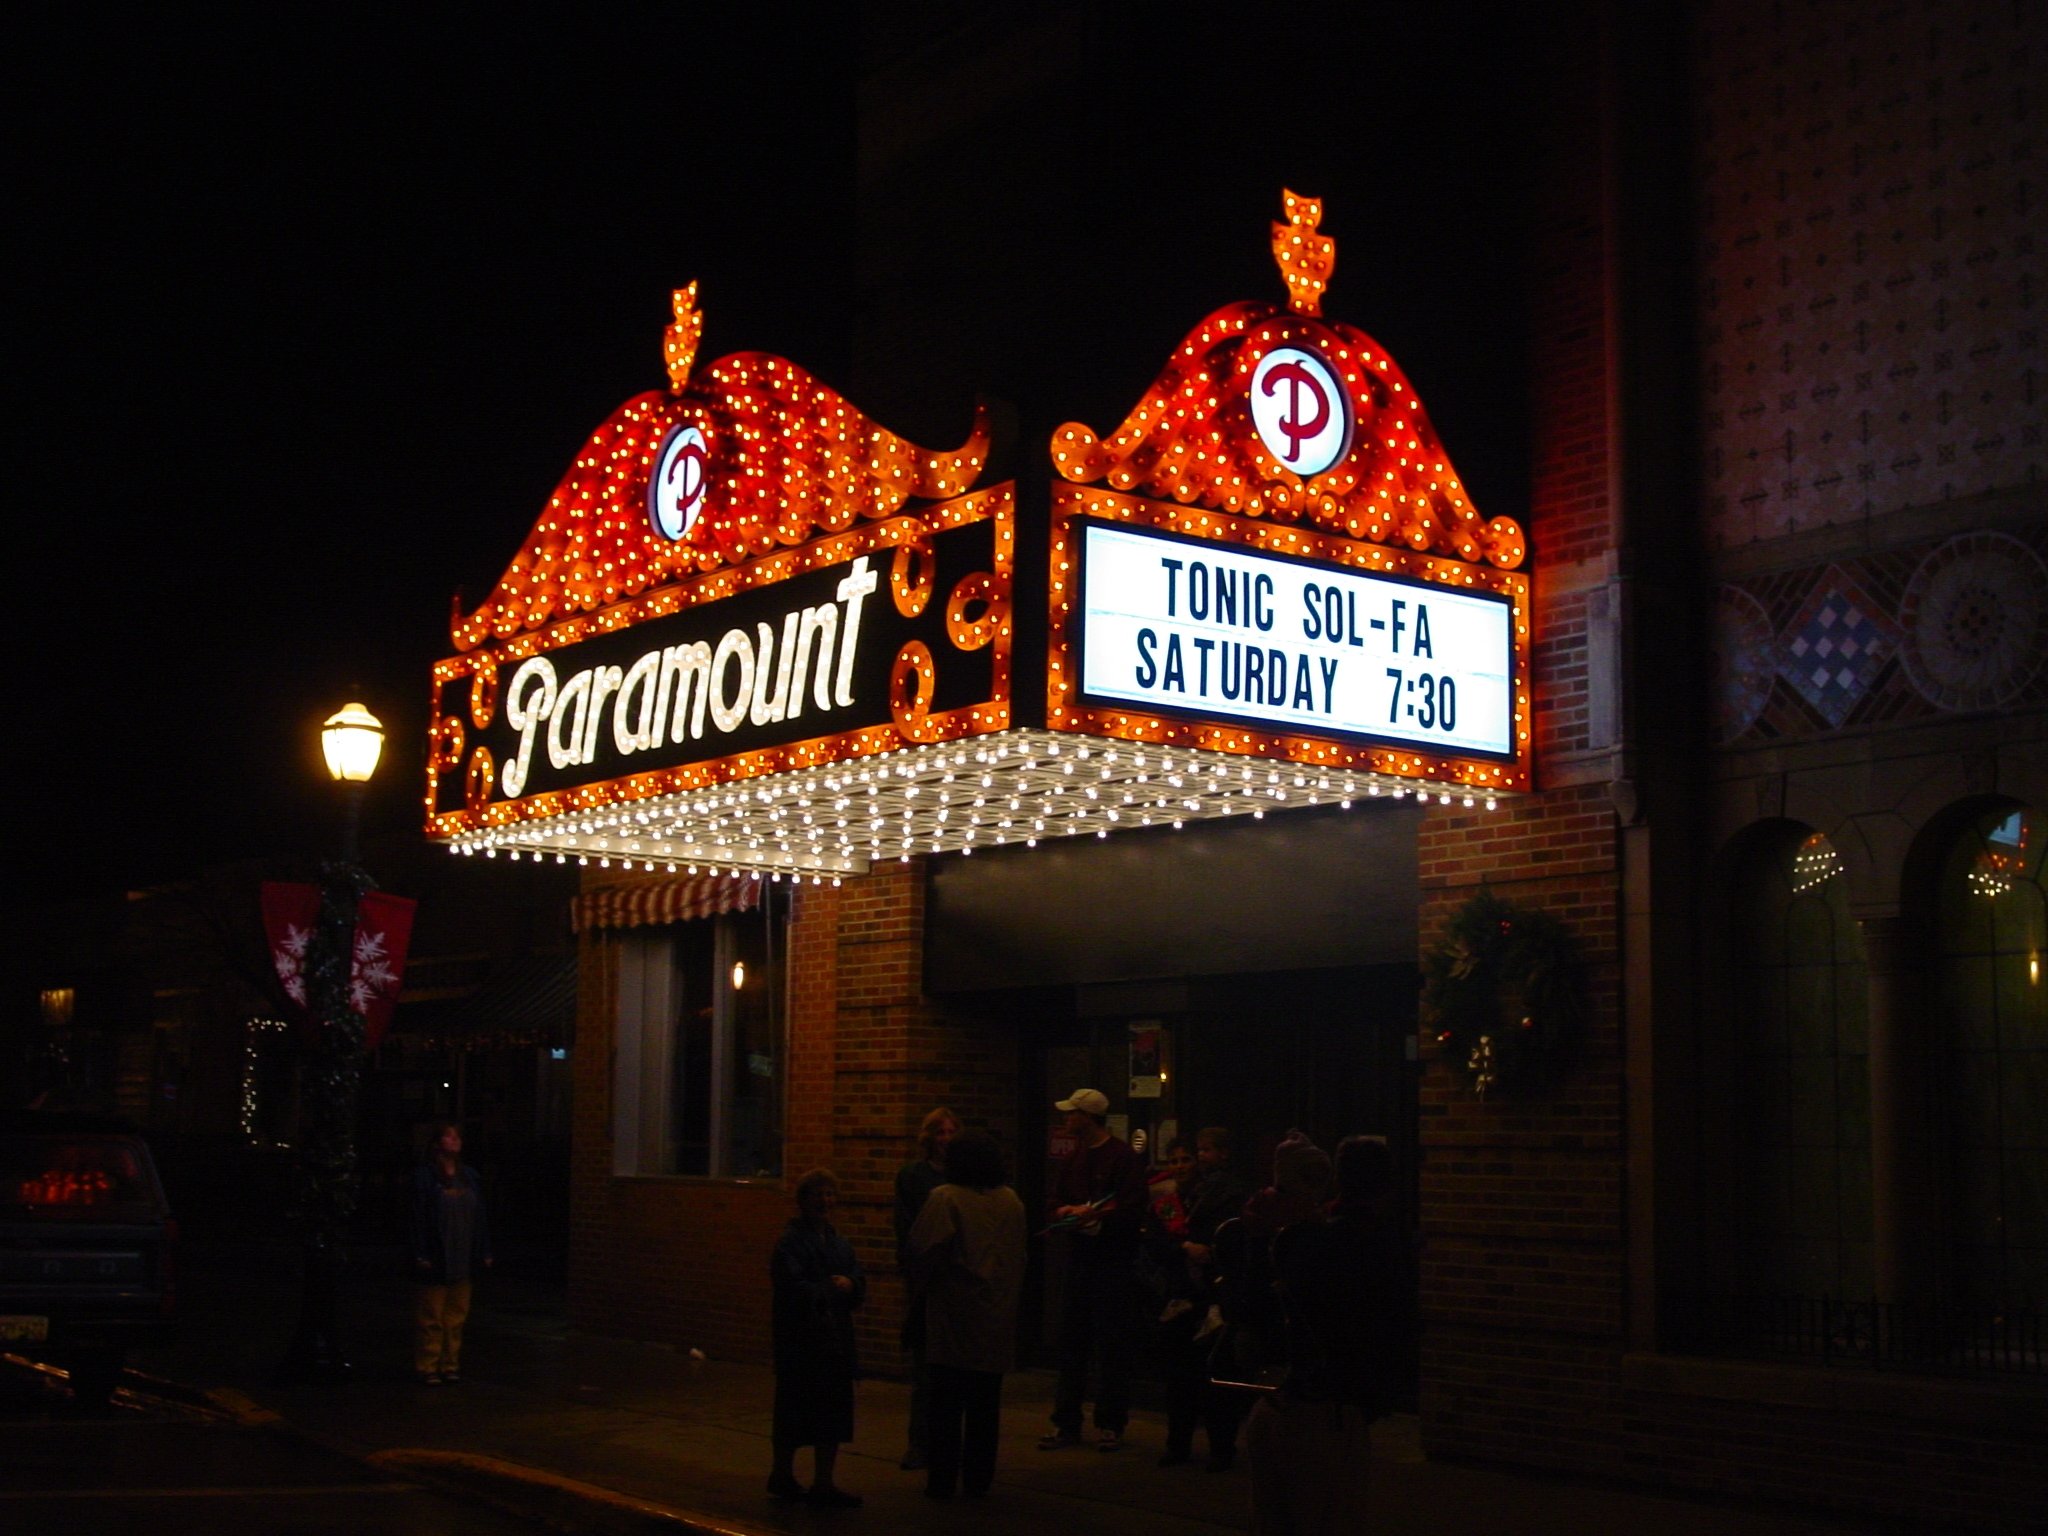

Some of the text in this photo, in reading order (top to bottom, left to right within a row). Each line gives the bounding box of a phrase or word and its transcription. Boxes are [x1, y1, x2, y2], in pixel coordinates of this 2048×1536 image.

[1261, 359, 1330, 463] P
[667, 434, 706, 533] P
[1161, 557, 1433, 659] TONIC SOL-FA
[501, 555, 879, 799] Paramount
[1135, 627, 1456, 732] SATURDAY 7:30
